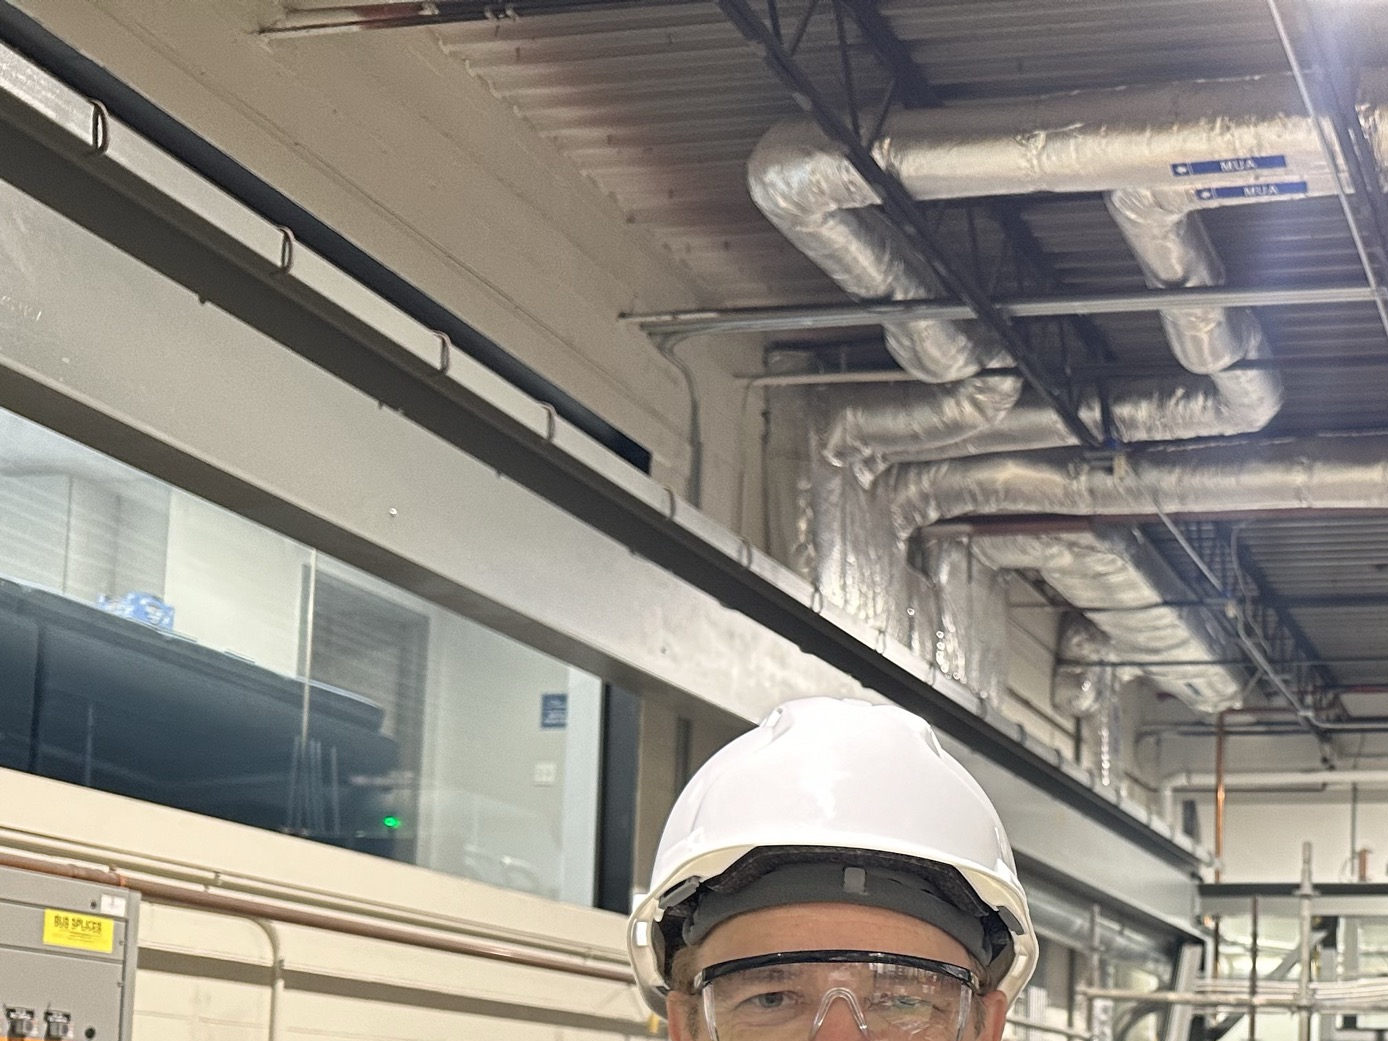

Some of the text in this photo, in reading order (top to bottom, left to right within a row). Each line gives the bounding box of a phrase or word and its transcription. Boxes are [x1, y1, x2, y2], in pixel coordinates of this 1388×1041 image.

[1220, 159, 1256, 172] MUA
[1243, 184, 1278, 195] MUA
[71, 917, 102, 934] SPLICES
